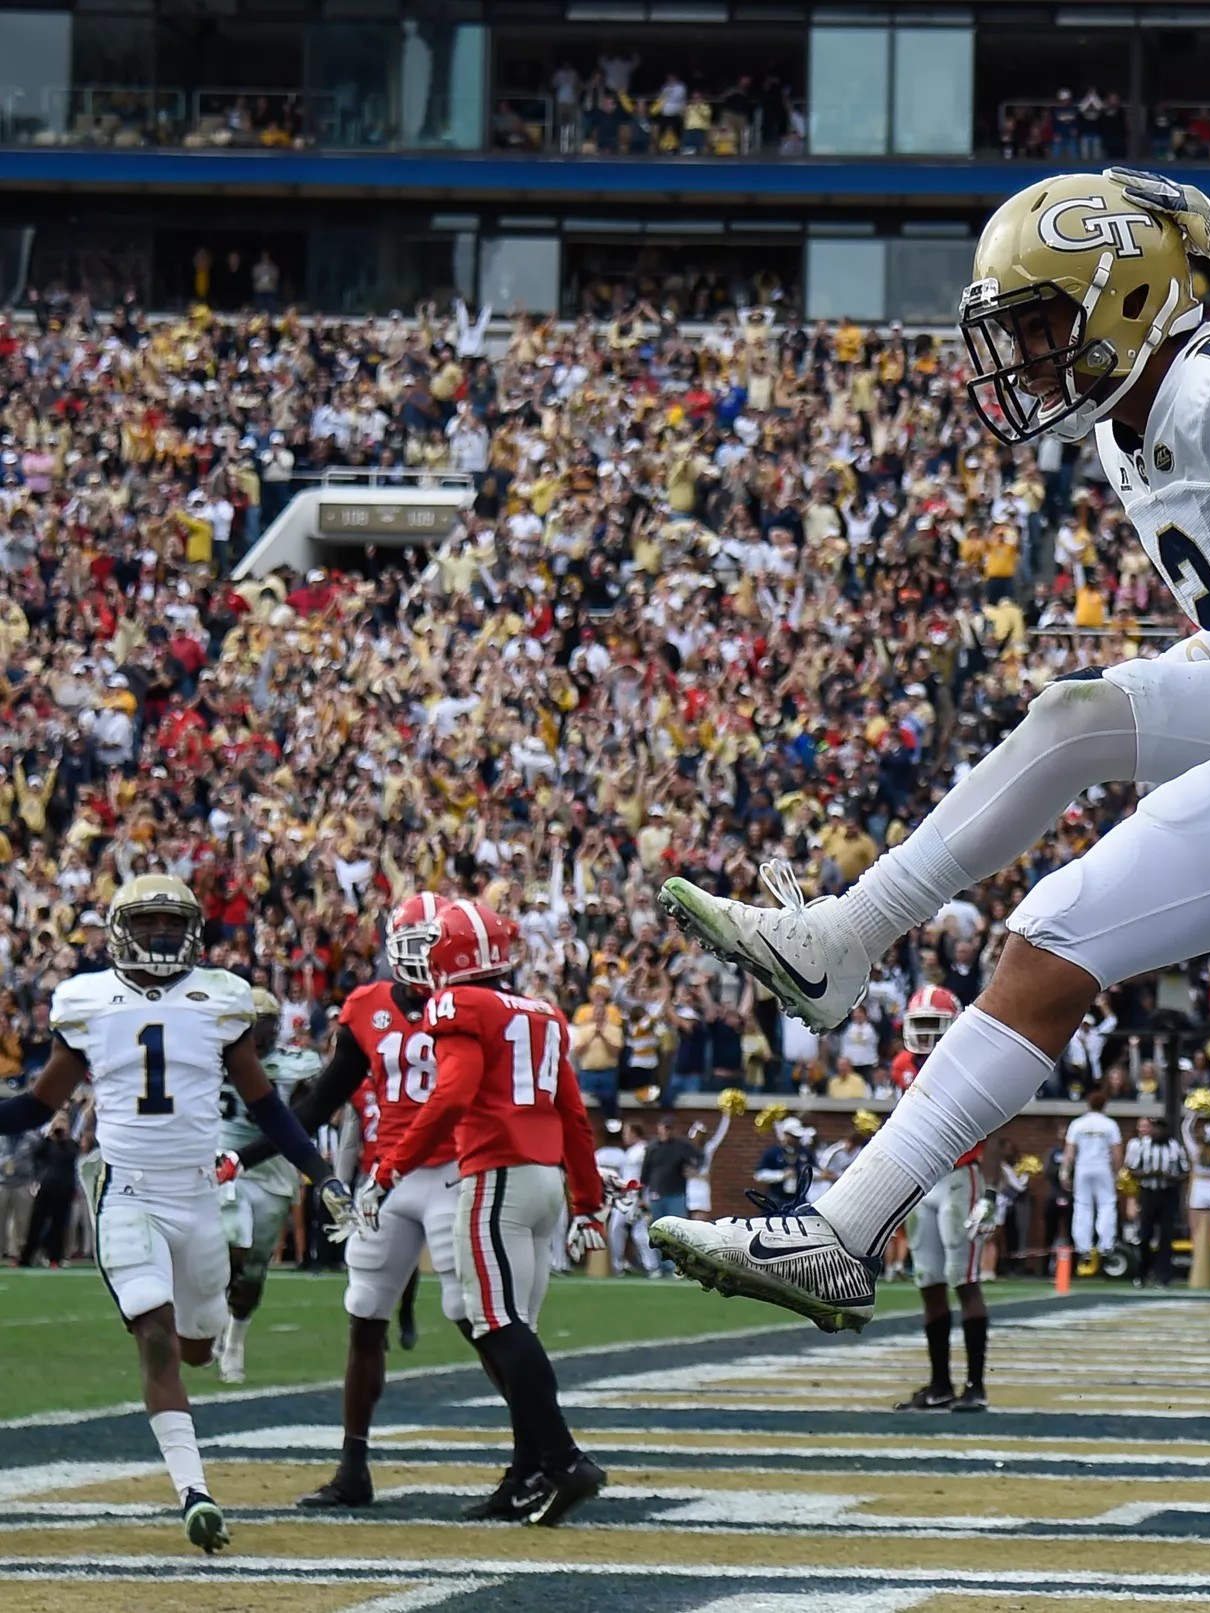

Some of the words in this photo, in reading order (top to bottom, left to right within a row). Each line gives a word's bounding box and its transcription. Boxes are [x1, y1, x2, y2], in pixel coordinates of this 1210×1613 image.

[1038, 196, 1153, 259] GT
[427, 992, 456, 1026] 14
[136, 1022, 175, 1115] 1
[376, 1031, 437, 1104] 18
[504, 1014, 561, 1105] 14
